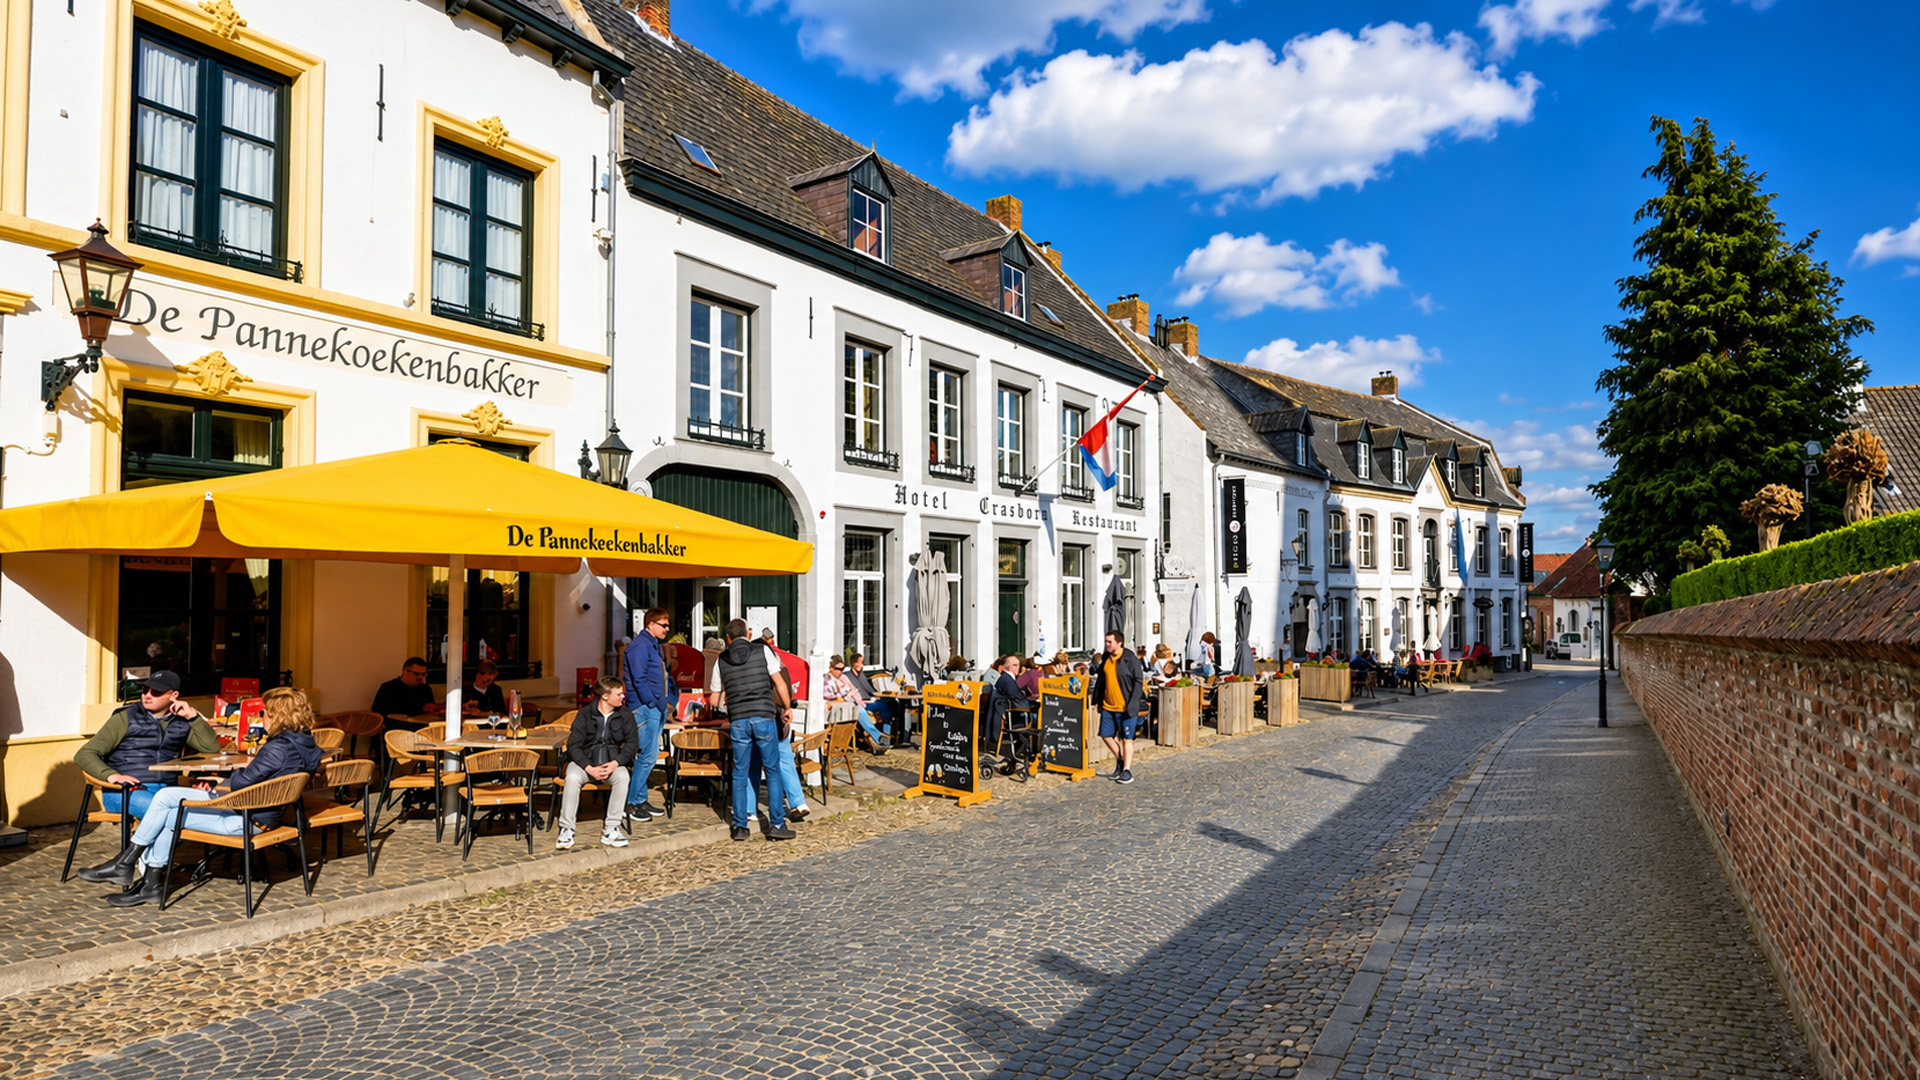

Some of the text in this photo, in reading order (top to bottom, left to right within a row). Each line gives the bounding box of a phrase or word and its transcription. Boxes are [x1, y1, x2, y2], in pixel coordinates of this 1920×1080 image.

[118, 288, 540, 399] De Pannekoekenbakker
[894, 483, 1138, 533] Hotel Crasborn Restaurant
[507, 524, 687, 557] De Pannekeekenbakker
